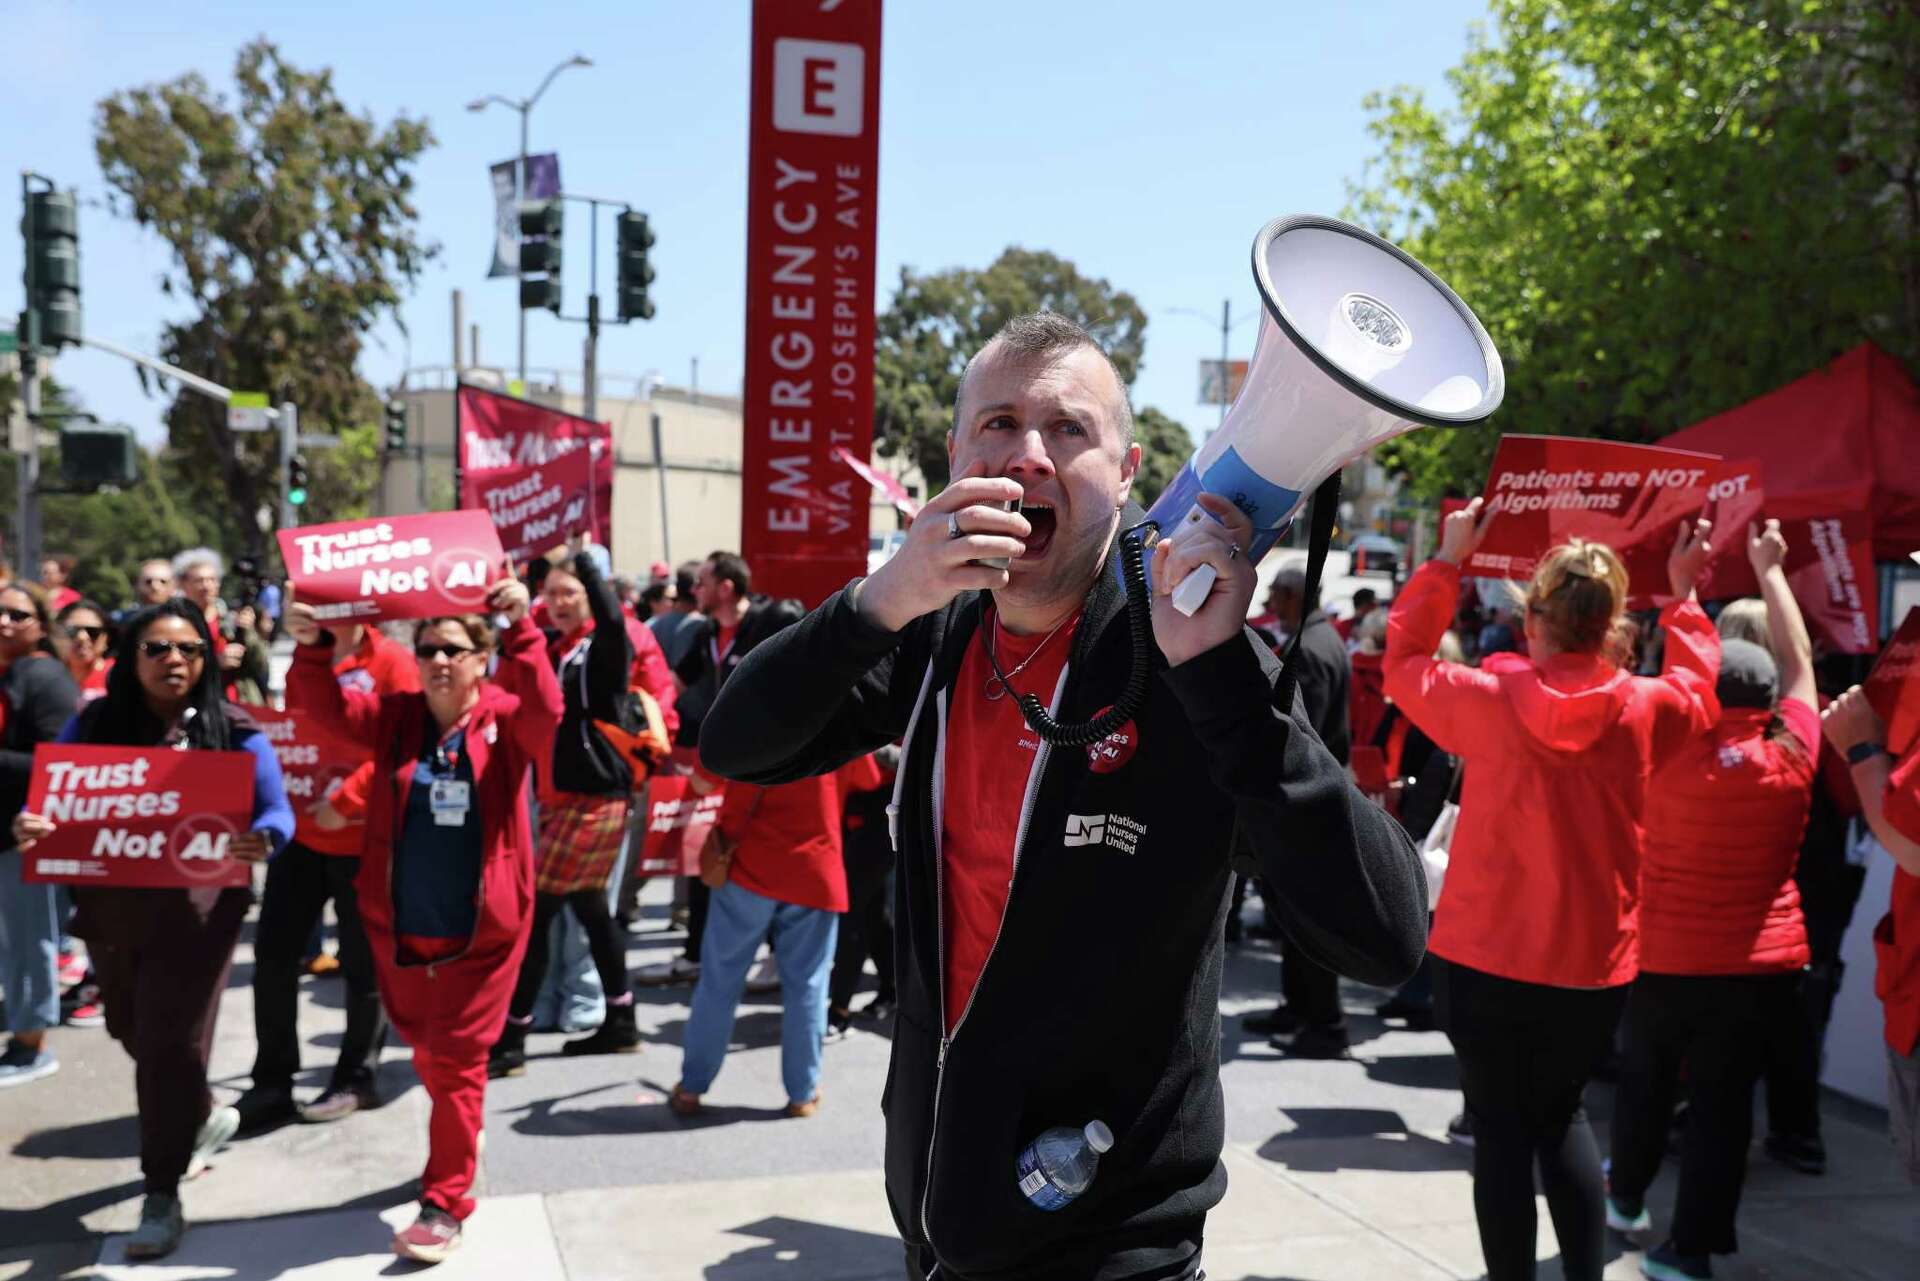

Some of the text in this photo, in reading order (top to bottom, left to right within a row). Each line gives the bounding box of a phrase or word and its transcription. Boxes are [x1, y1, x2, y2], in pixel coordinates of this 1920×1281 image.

[836, 163, 861, 228] AVE
[831, 245, 860, 401] JOSEPH'S
[768, 159, 817, 531] EMERGENCY
[485, 471, 543, 509] Trust
[1496, 467, 1705, 490] Patients are NOT
[490, 485, 563, 529] Nurses
[829, 480, 852, 534] VIA
[1485, 490, 1621, 514] Algorithms
[294, 523, 393, 555] Trust
[523, 514, 559, 543] Not
[301, 537, 432, 575] Nurses
[360, 559, 488, 596] Not AI
[46, 757, 149, 792] Trust
[42, 790, 180, 823] Nurses
[1107, 824, 1138, 844] Nurses
[1108, 813, 1147, 835] National
[91, 827, 231, 861] Not AI
[1105, 835, 1136, 855] United
